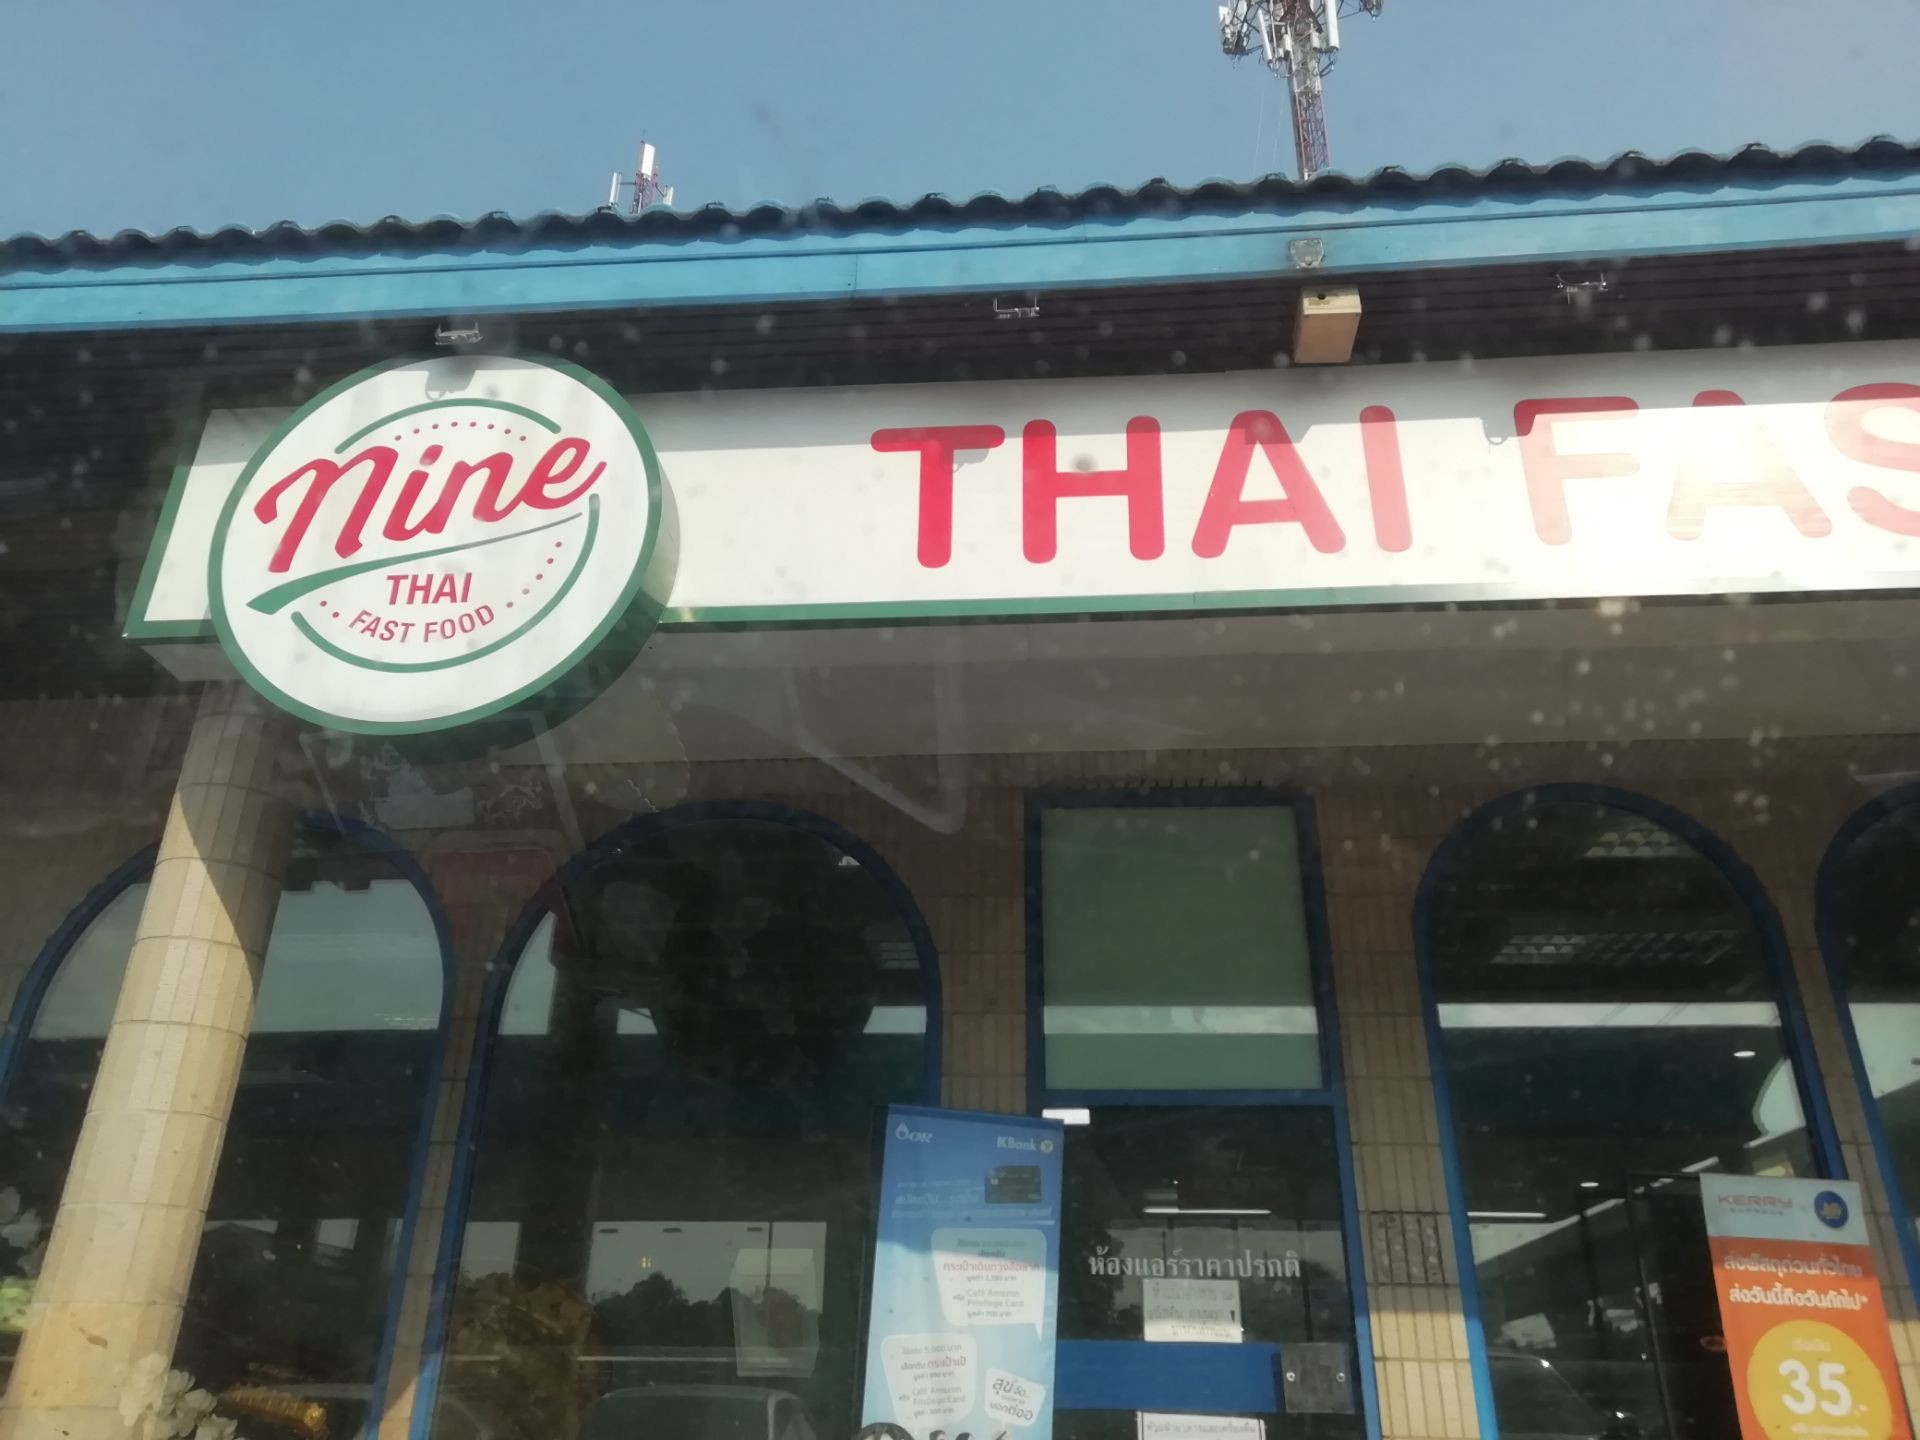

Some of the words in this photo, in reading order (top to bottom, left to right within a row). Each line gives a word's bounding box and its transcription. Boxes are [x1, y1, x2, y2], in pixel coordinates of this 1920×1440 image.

[870, 404, 1413, 569] THAI
[386, 572, 471, 605] THAI
[349, 609, 415, 643] FAST
[423, 603, 495, 643] FOOD
[996, 1135, 1038, 1152] KBank
[1718, 1194, 1793, 1208] KERRY
[1088, 1245, 1302, 1278] ห้องแอร์ราคาปรกติ
